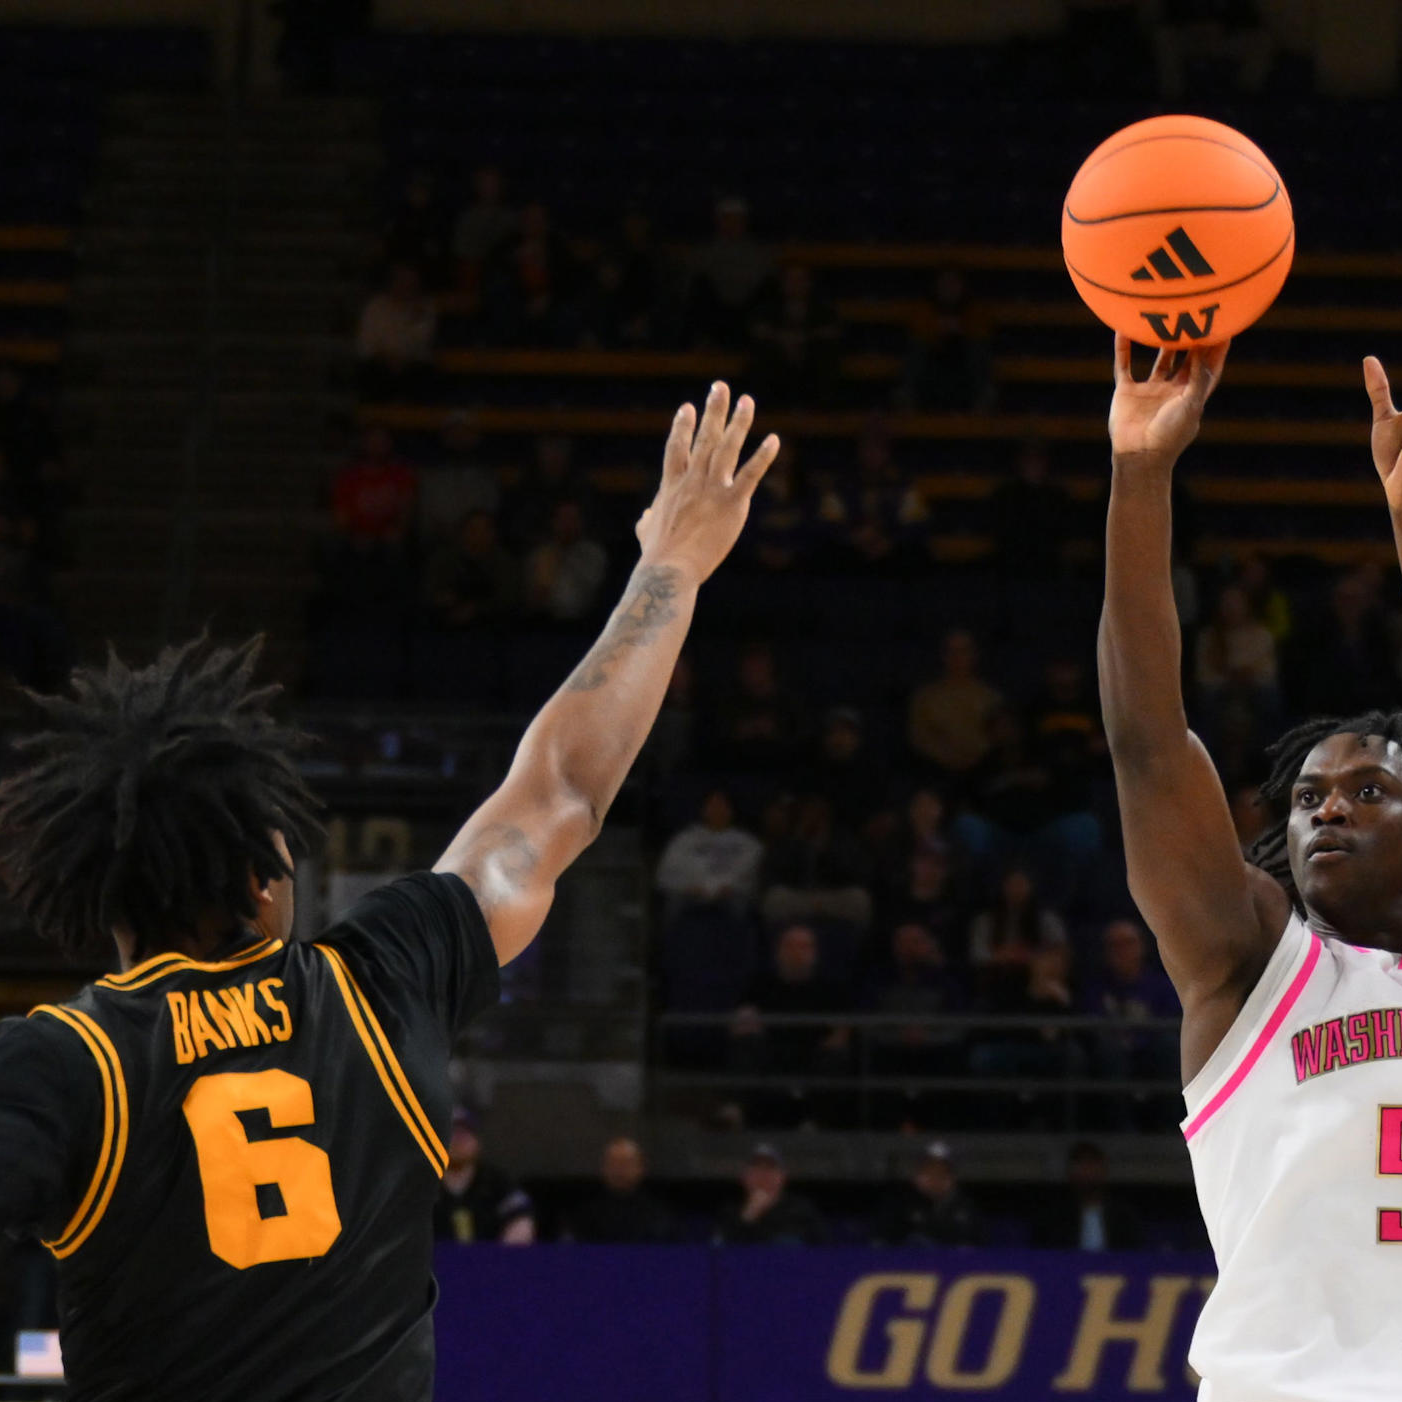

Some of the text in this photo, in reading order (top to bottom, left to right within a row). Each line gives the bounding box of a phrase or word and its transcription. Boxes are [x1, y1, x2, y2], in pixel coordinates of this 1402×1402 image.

[1140, 303, 1220, 341] W
[165, 976, 293, 1065] BANKS
[182, 1068, 342, 1270] 6
[826, 1272, 1036, 1390] GO
